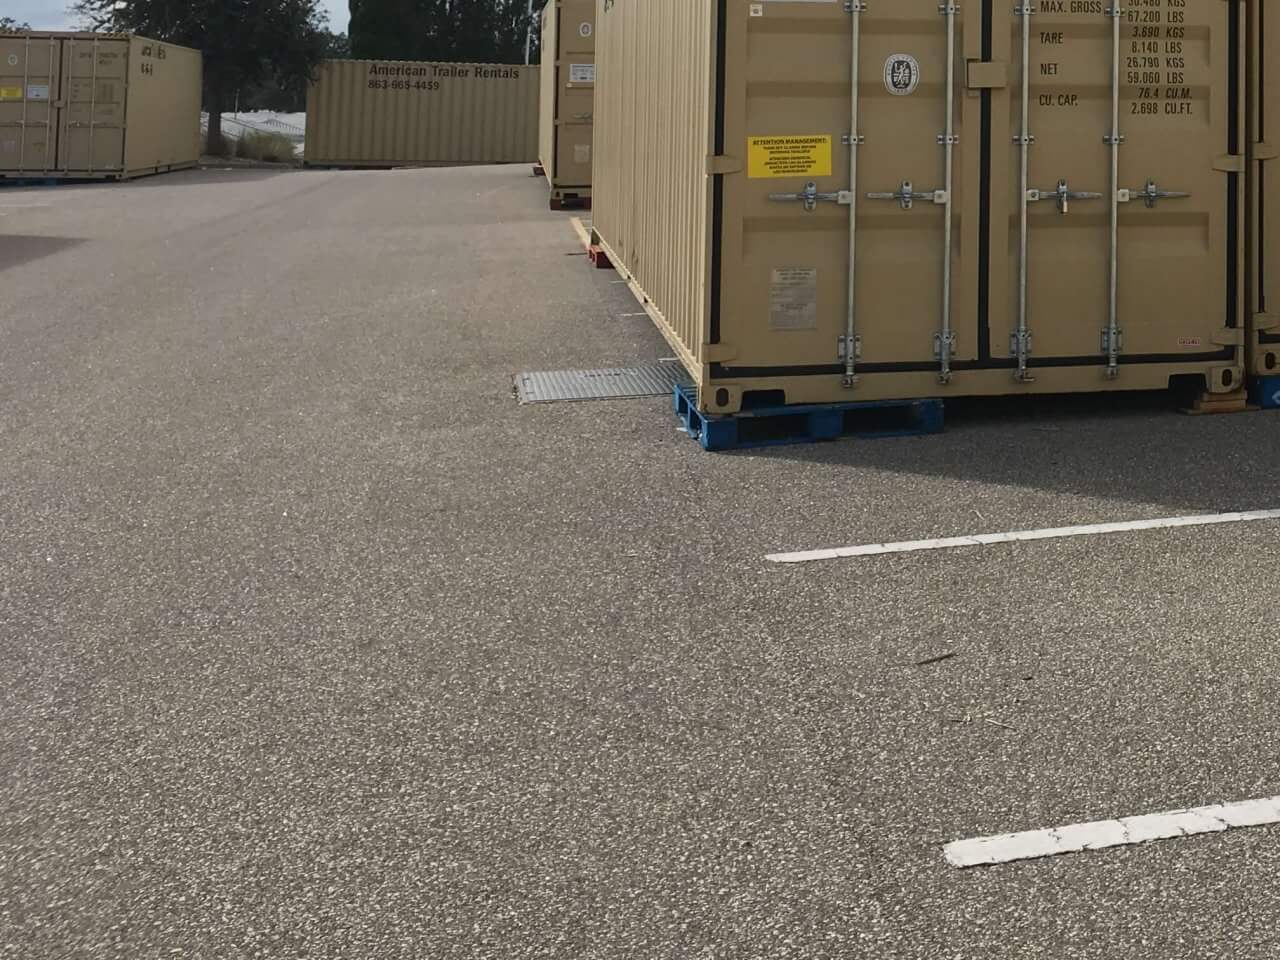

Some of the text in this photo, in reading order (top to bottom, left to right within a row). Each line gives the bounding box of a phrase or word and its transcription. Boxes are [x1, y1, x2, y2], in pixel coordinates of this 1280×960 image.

[1040, 0, 1102, 14] MAX. GROSS
[1127, 11, 1184, 23] 67.200 LBS
[1040, 32, 1064, 44] TARE
[1166, 26, 1185, 38] KGS
[1131, 41, 1182, 54] 8.140 LBS
[1166, 57, 1185, 68] KGS
[369, 63, 520, 79] American Trailer Rentals
[1040, 63, 1058, 75] NET
[1127, 72, 1184, 84] 59.060 LBS
[368, 79, 440, 90] 863-665-4459
[1039, 94, 1078, 107] CU. CAP.
[1165, 102, 1193, 115] CU.FT.
